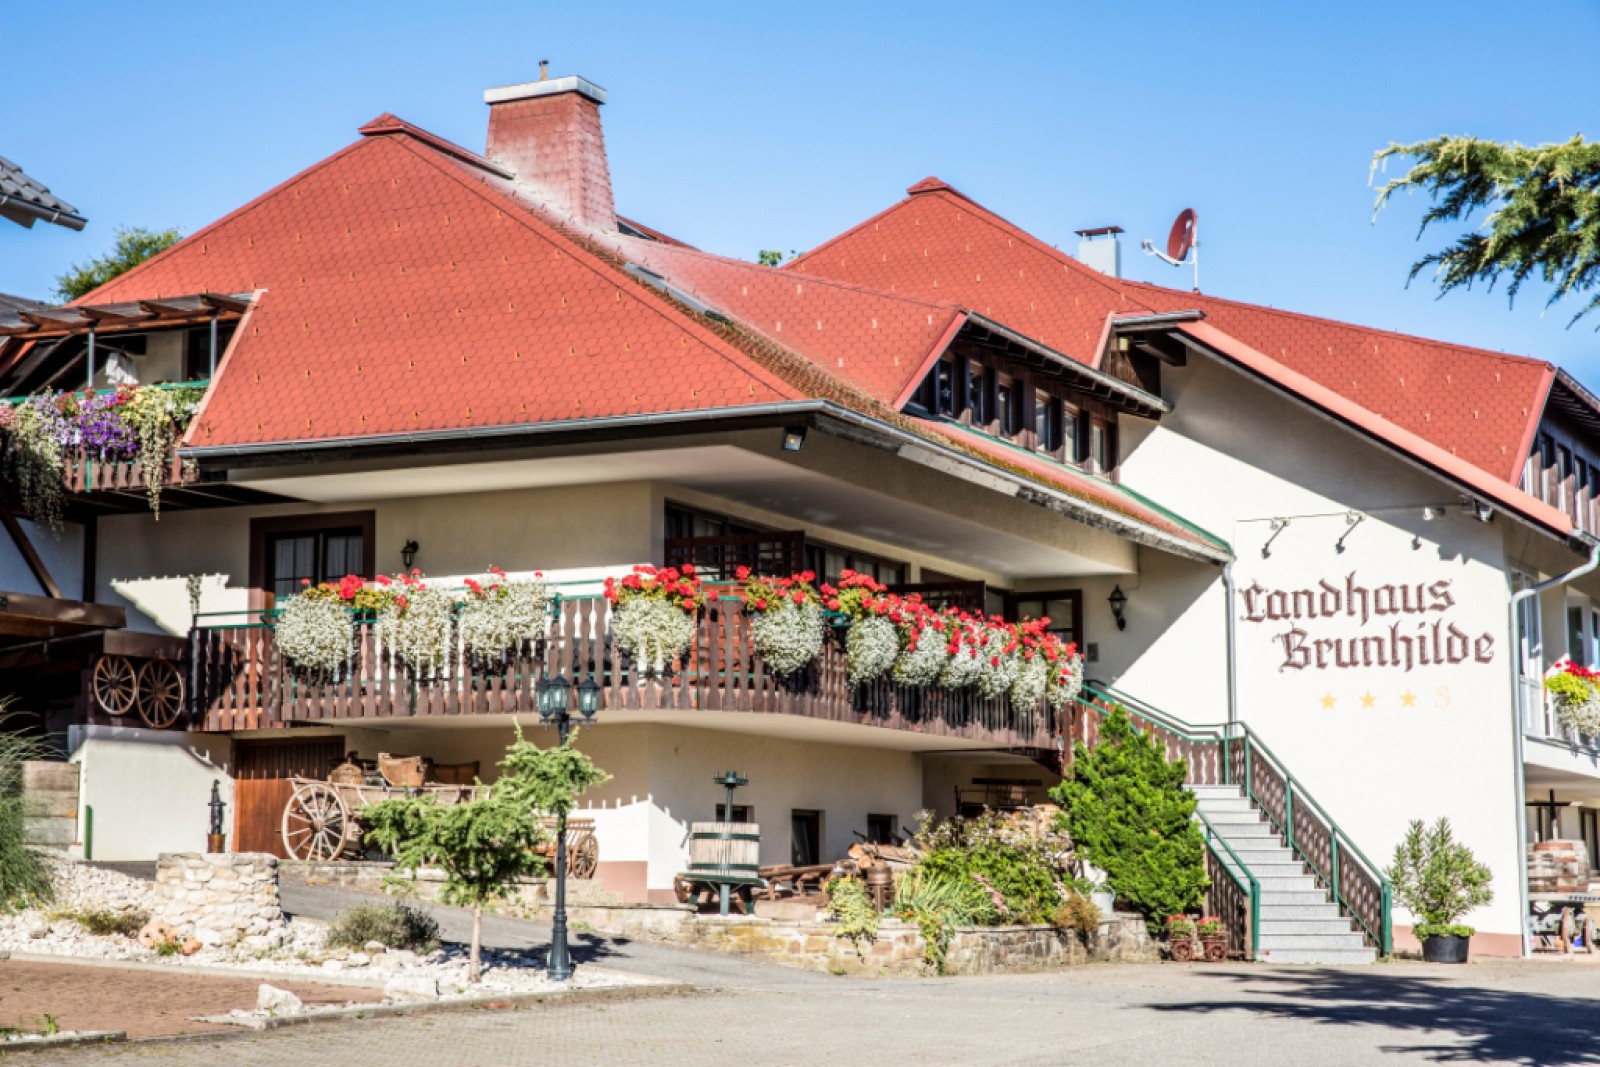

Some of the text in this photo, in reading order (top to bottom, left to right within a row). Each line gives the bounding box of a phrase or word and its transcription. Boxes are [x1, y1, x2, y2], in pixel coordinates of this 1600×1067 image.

[1239, 571, 1455, 626] Landhaus
[1272, 618, 1494, 673] Brunhilde
[1434, 685, 1451, 709] S
